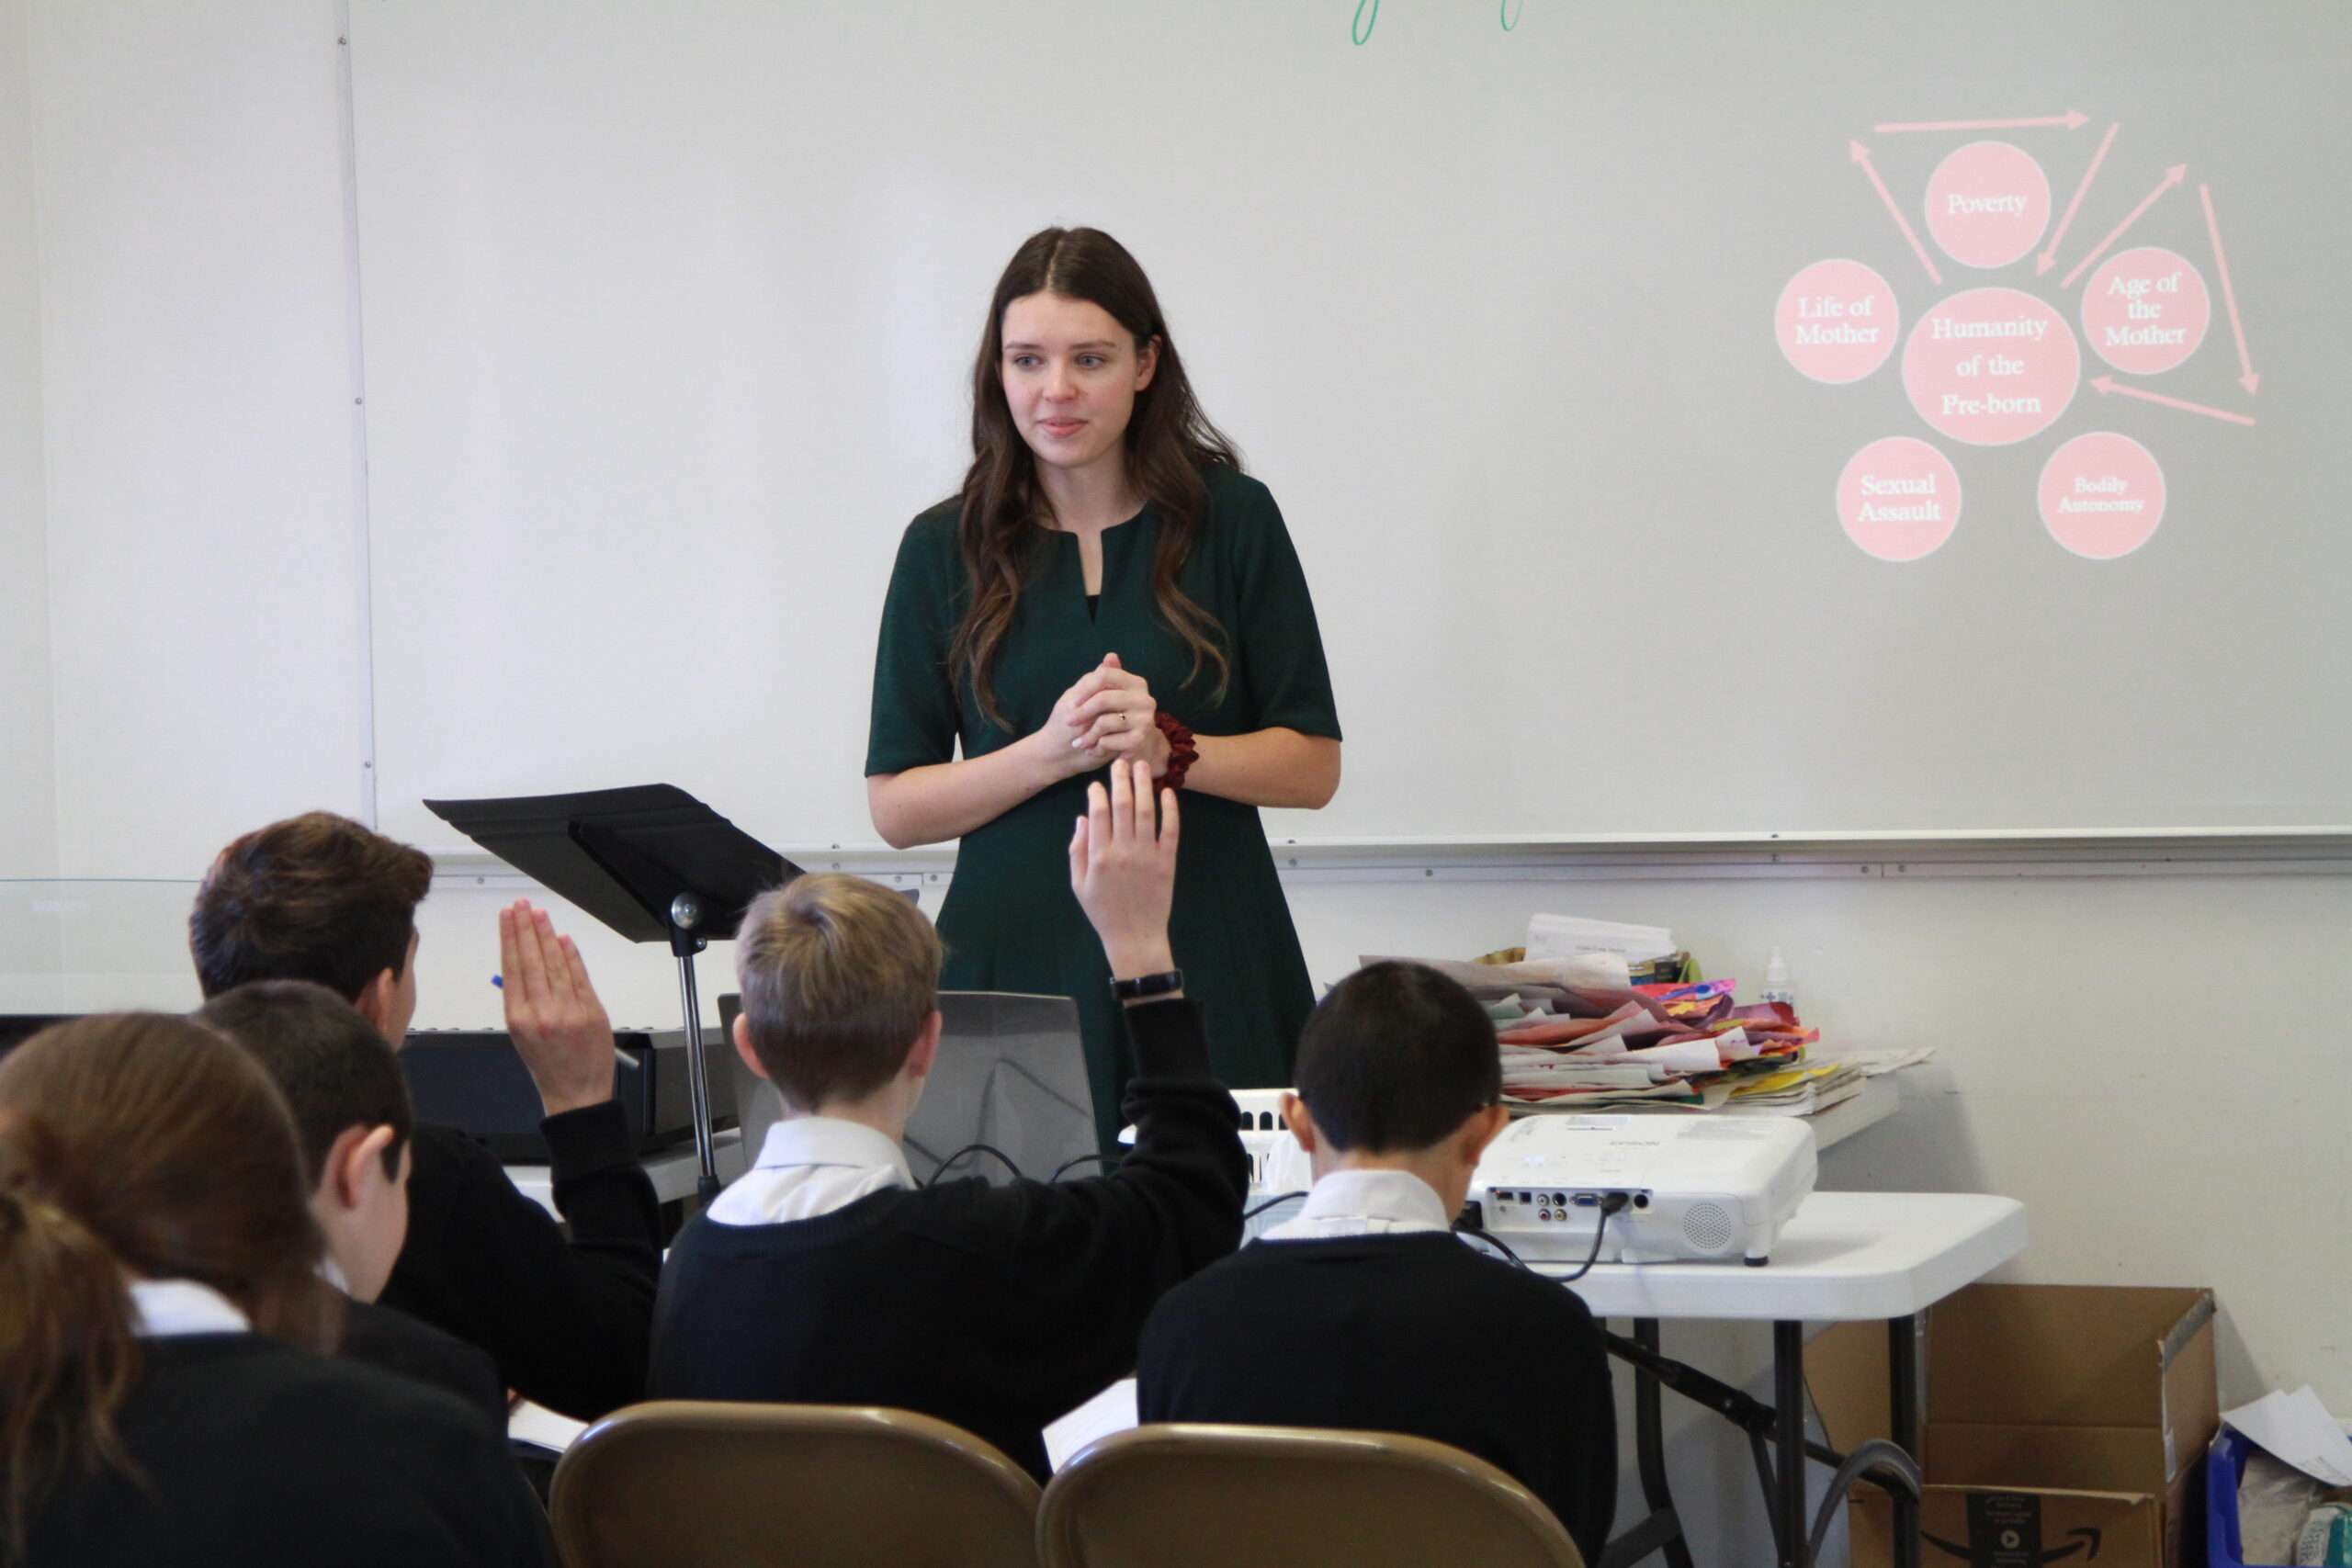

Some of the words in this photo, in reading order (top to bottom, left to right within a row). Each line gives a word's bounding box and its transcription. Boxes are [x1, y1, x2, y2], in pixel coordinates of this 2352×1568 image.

[1947, 193, 2029, 218] Poverty
[2107, 276, 2152, 299] Age
[2155, 271, 2182, 294] of
[1797, 295, 1843, 319] Life
[1849, 294, 1876, 318] of
[2127, 299, 2163, 321] the
[1794, 323, 1881, 345] Mother
[1931, 315, 2049, 341] Humanity
[2104, 325, 2187, 346] Mother
[1955, 354, 1982, 378] of
[1988, 353, 2025, 377] the
[1940, 392, 2042, 416] Pre-born
[1860, 473, 1937, 496] Sexual
[2074, 476, 2129, 496] Bodily
[1856, 502, 1942, 524] Assault
[2056, 497, 2145, 514] Autonomy
